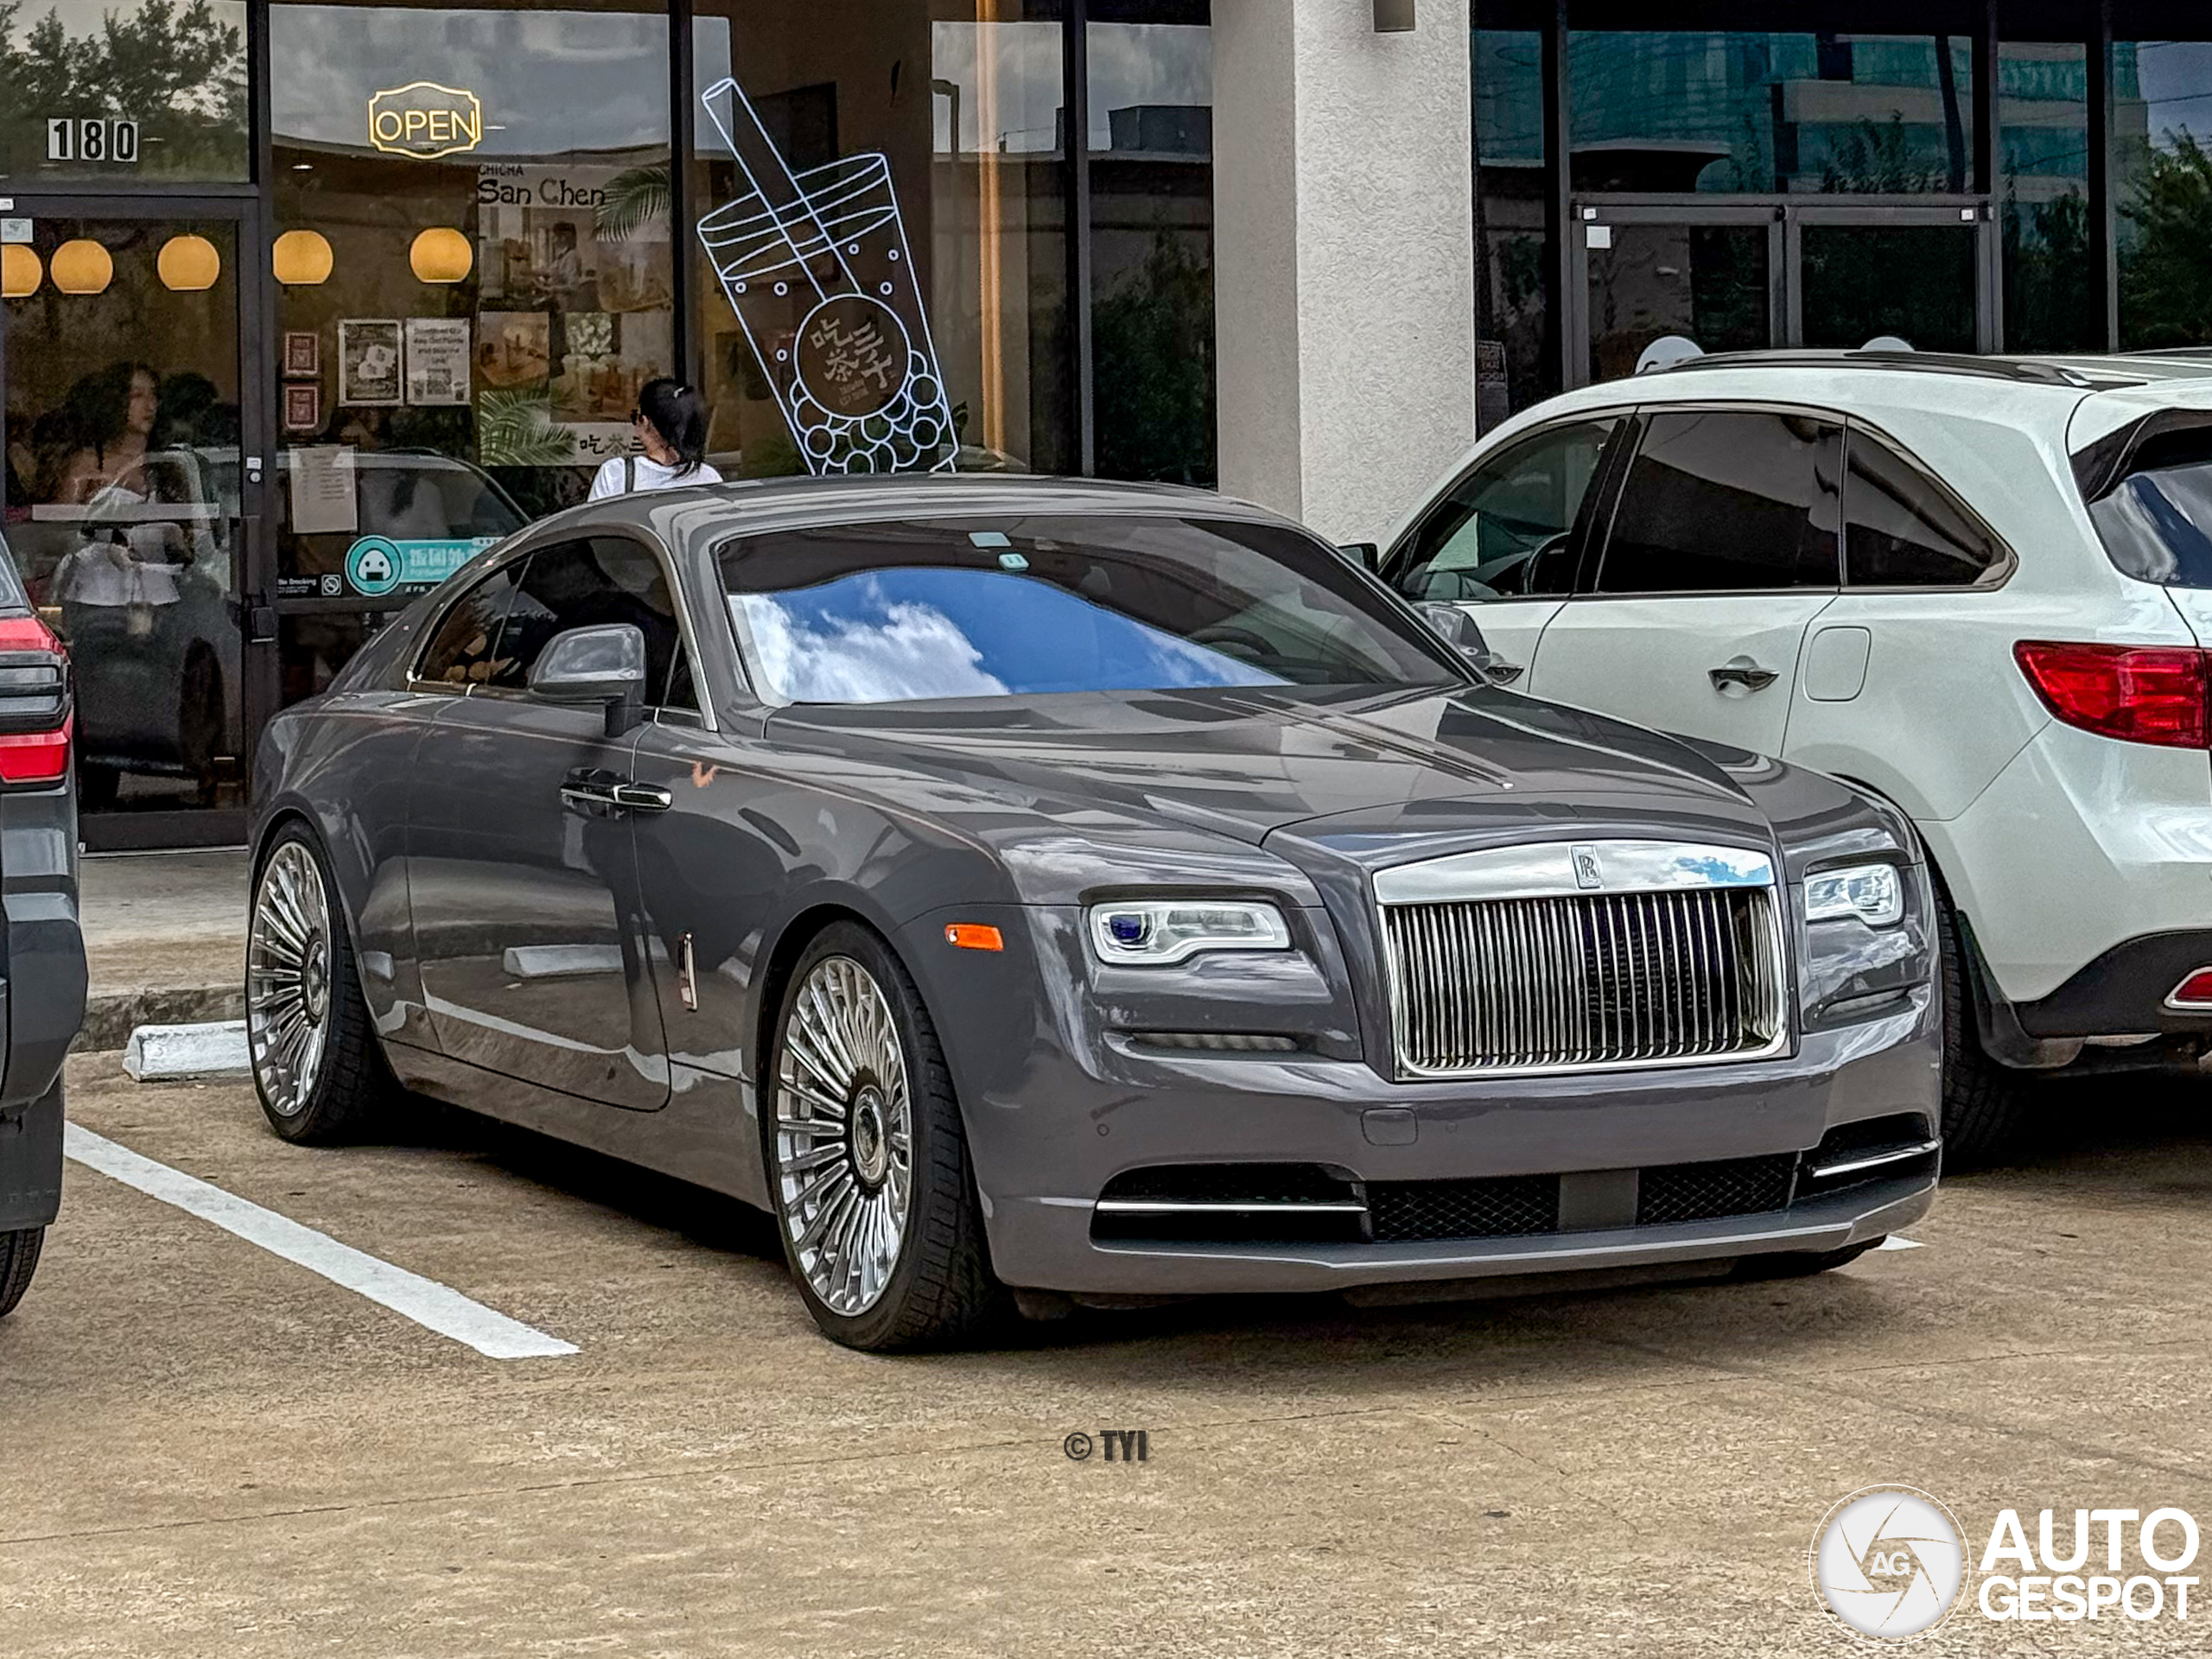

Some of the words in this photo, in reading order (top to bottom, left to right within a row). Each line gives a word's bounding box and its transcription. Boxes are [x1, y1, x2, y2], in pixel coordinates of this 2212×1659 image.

[54, 121, 135, 159] 180
[374, 110, 476, 142] OPEN
[477, 179, 531, 205] San
[539, 177, 605, 206] Chen
